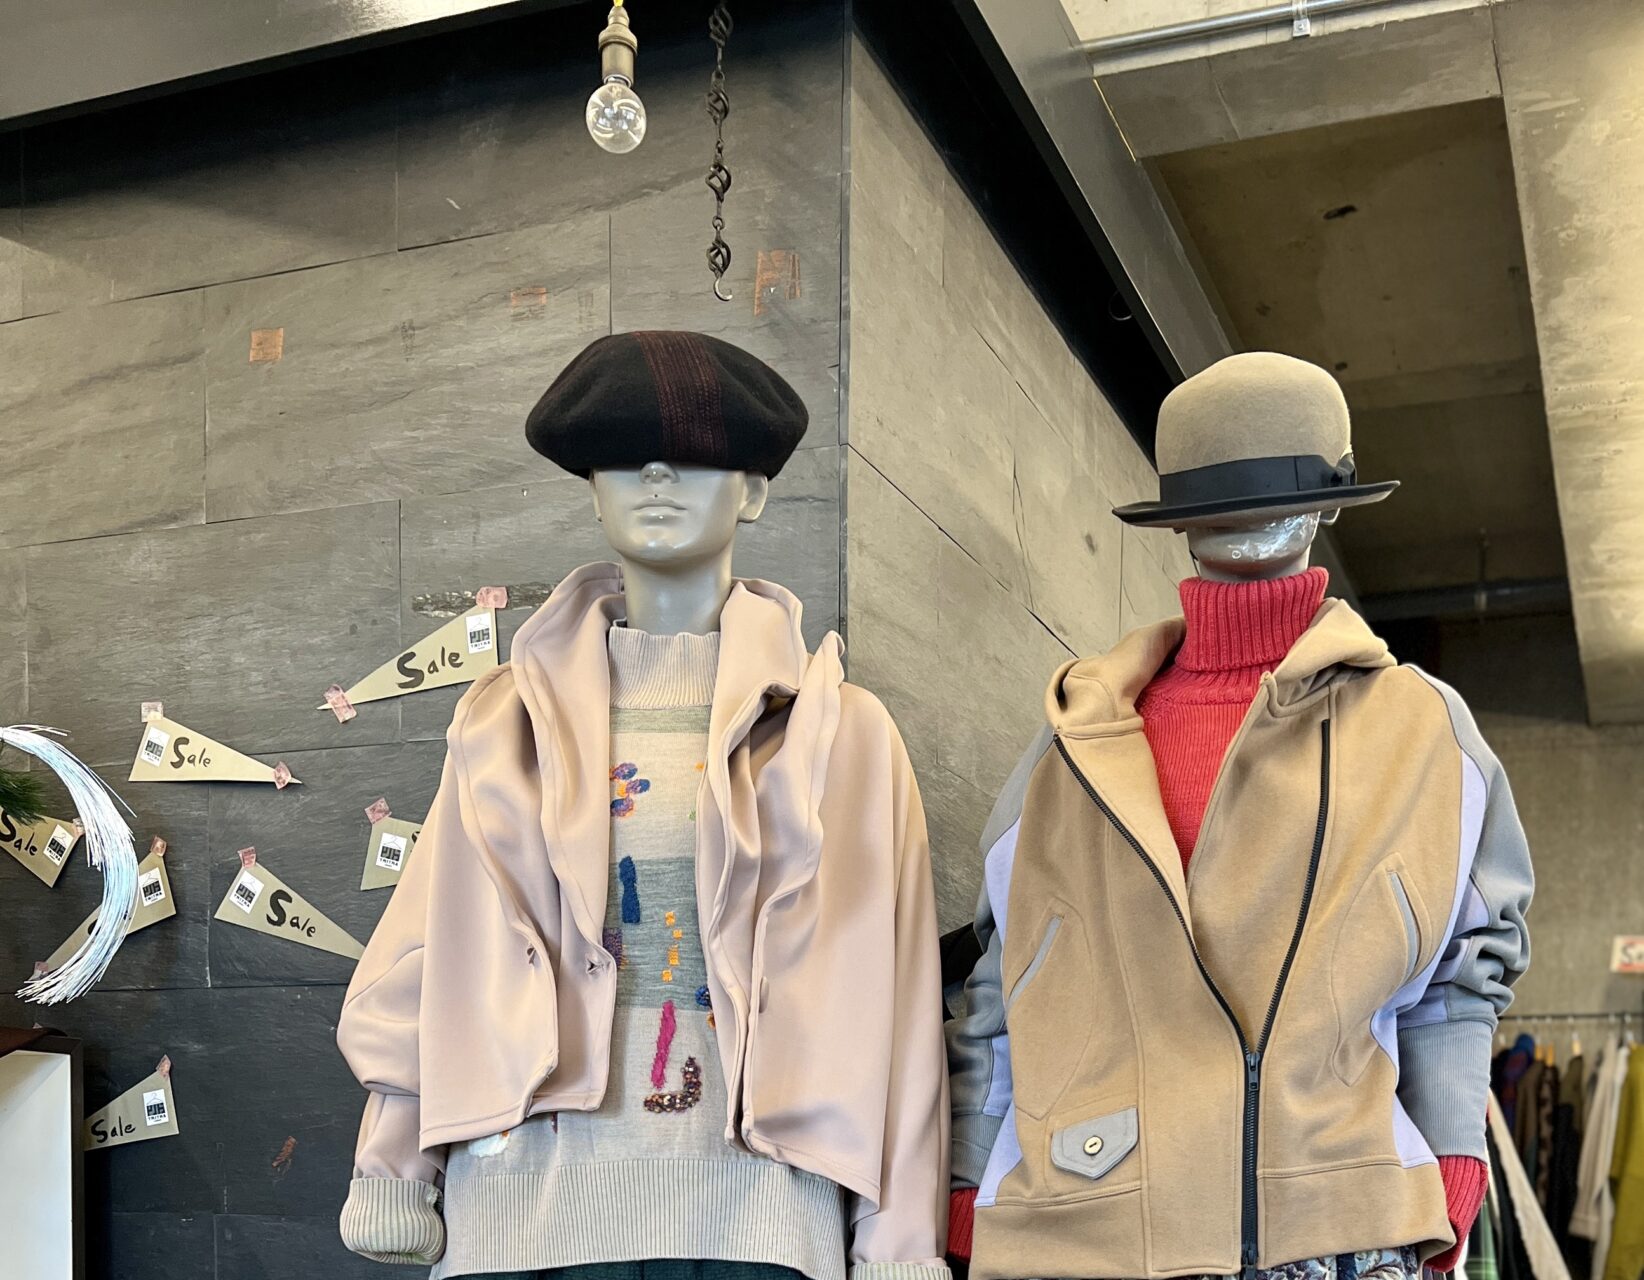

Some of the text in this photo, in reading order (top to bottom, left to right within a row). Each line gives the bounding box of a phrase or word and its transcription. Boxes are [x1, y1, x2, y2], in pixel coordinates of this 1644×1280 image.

[396, 646, 464, 689] Sale
[170, 736, 211, 769] Sale
[266, 889, 316, 937] Sale
[91, 1115, 136, 1143] Sale
